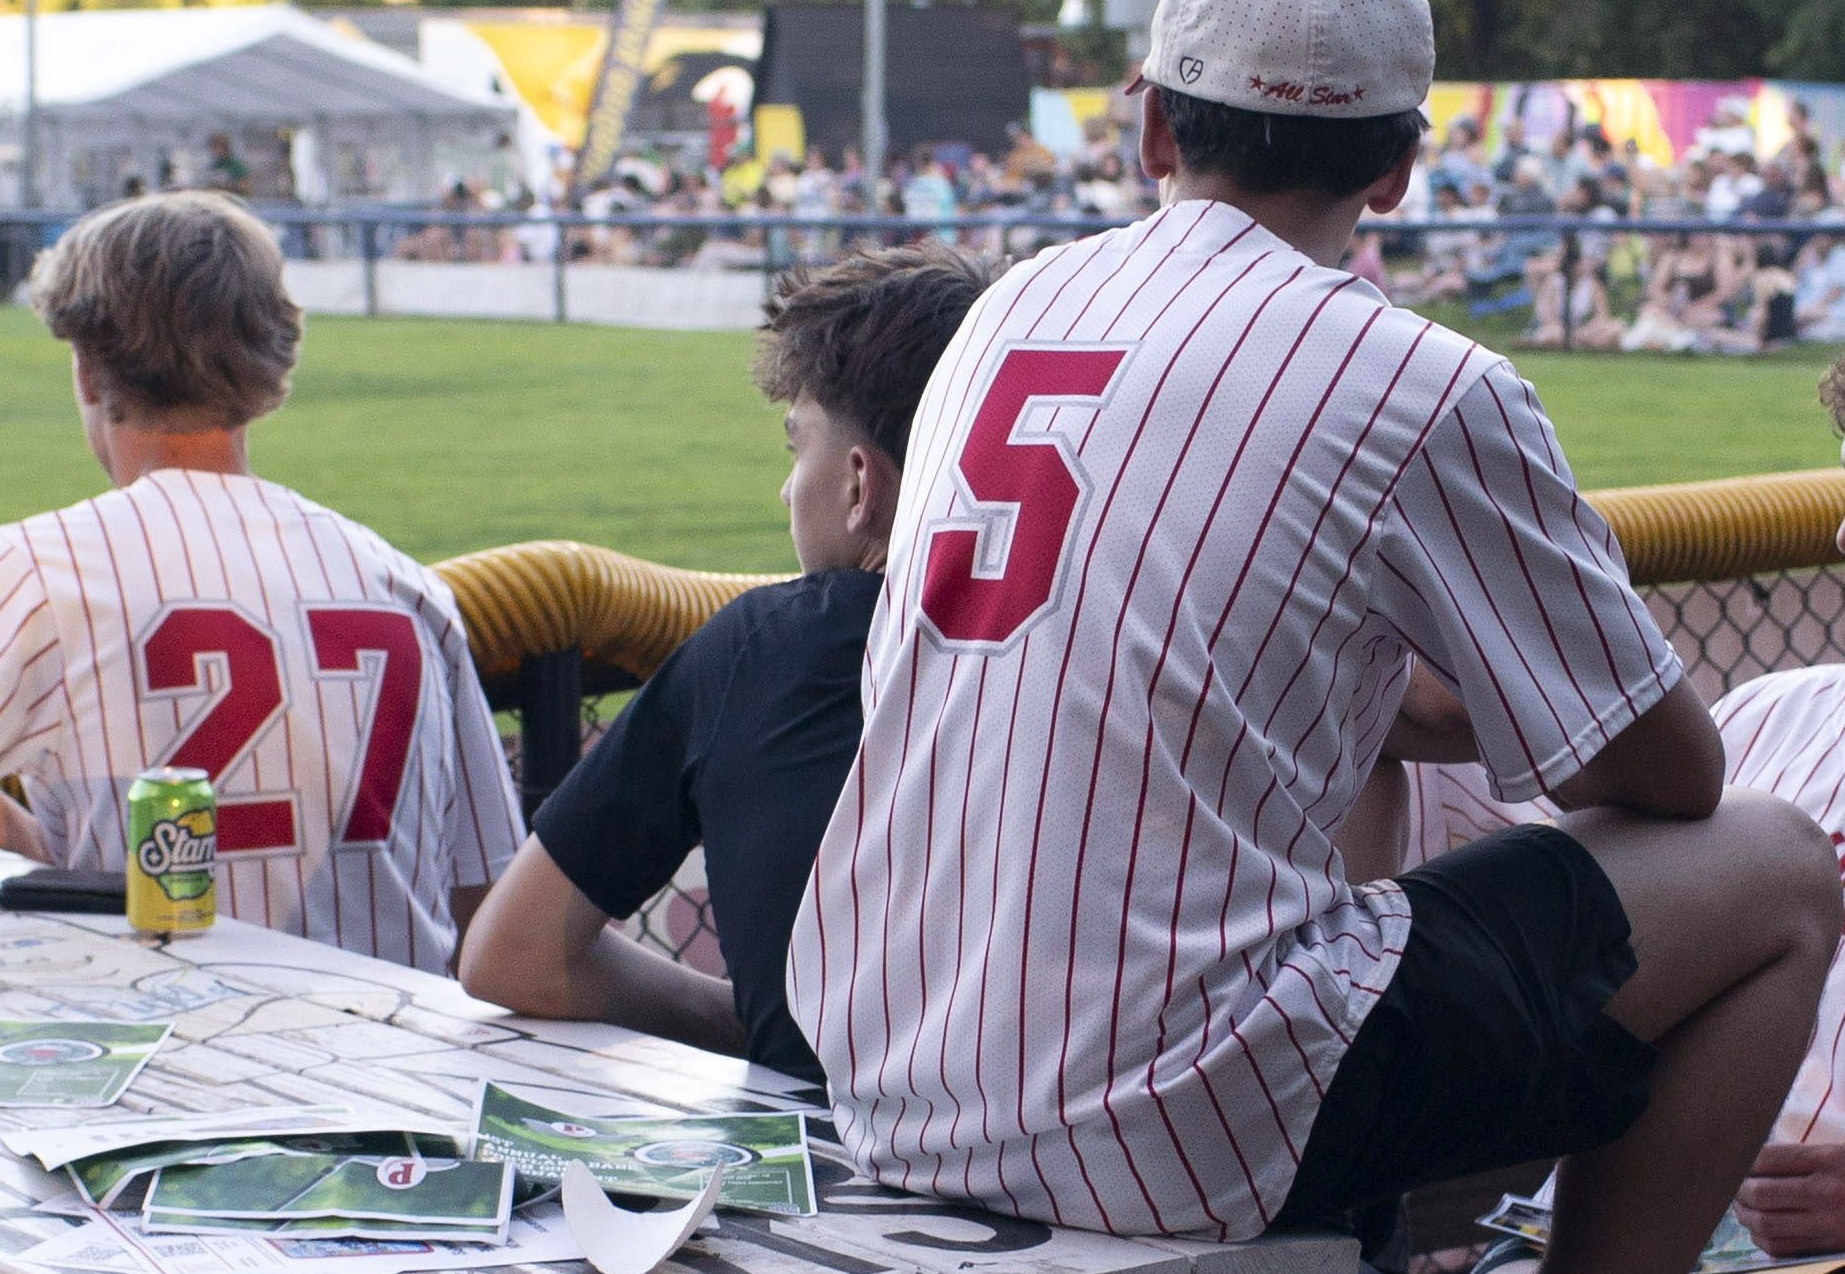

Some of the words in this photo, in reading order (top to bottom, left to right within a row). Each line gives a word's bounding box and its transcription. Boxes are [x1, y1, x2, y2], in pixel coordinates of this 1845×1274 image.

[1264, 82, 1304, 102] All
[1309, 87, 1350, 106] Star
[917, 341, 1143, 656] 5
[135, 601, 423, 860] 27
[387, 1162, 416, 1186] P
